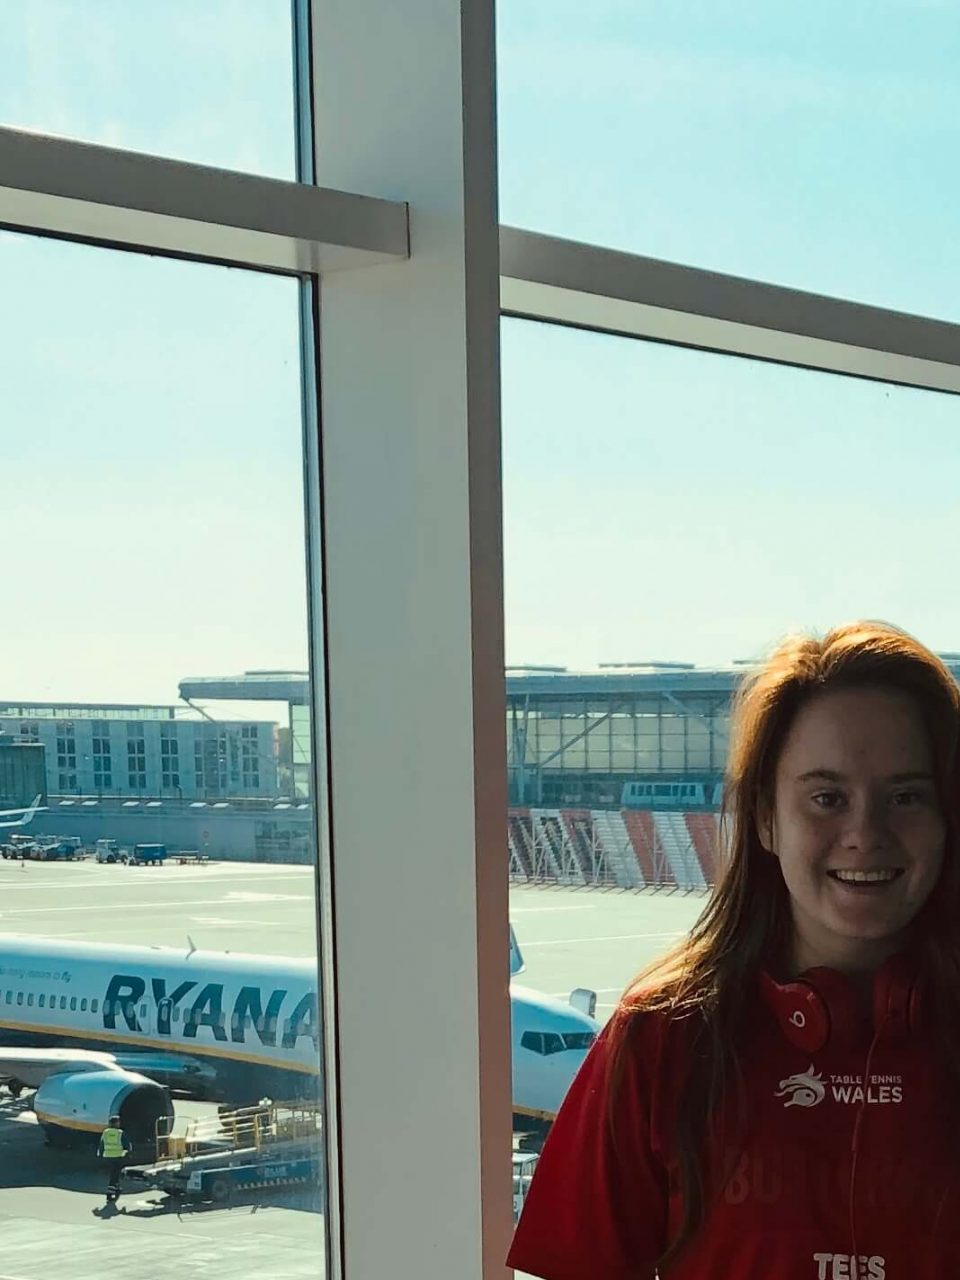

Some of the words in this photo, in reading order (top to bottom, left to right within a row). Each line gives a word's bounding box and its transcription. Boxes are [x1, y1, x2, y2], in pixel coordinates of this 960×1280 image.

[830, 1075, 863, 1084] TABLE
[867, 1075, 902, 1084] ENNIS
[831, 1085, 903, 1104] WALES
